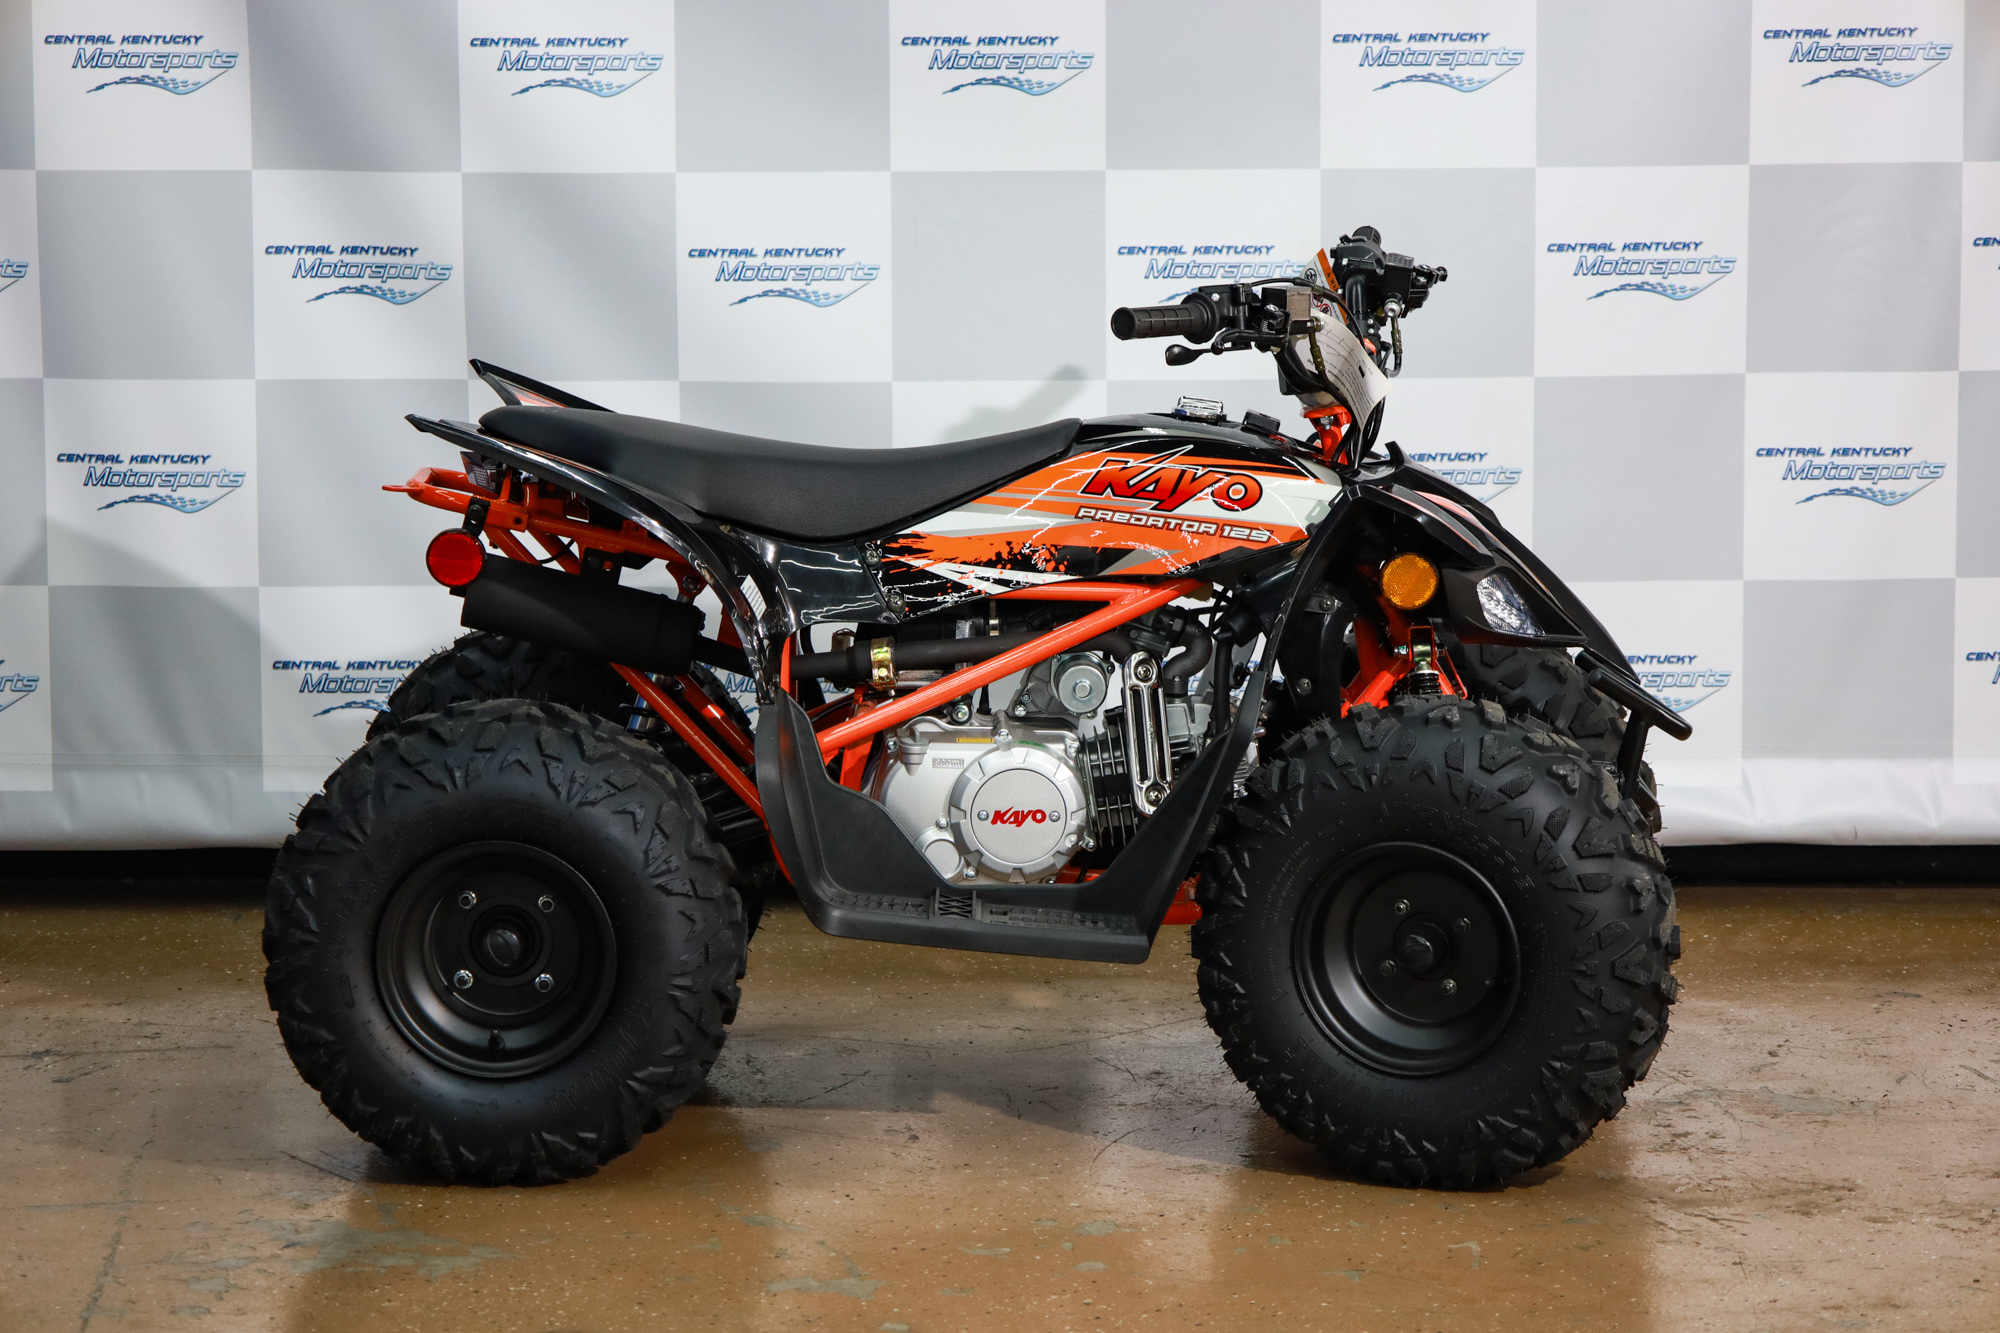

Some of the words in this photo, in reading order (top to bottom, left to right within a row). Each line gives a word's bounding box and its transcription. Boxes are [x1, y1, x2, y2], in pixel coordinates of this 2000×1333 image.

[45, 34, 115, 45] CENTRAL
[121, 34, 204, 45] KENTUCKY
[470, 37, 540, 47] CENTRAL
[546, 37, 629, 47] KENTUCKY
[901, 36, 971, 46] CENTRAL
[976, 36, 1059, 46] KENTUCKY
[1332, 33, 1401, 43] CENTRAL
[1407, 33, 1490, 42] KENTUCKY
[1763, 28, 1831, 39] CENTRAL
[1836, 27, 1917, 37] KENTUCKY
[72, 47, 239, 74] Motorsports
[497, 50, 664, 76] Motorsports
[928, 49, 1094, 74] Motorsports
[1359, 46, 1524, 70] Motorsports
[1789, 41, 1952, 65] Motorsports
[265, 245, 335, 255] CENTRAL
[340, 245, 419, 256] KENTUCKY
[688, 248, 758, 258] CENTRAL
[763, 248, 845, 258] KENTUCKY
[1117, 245, 1187, 255] CENTRAL
[1192, 245, 1274, 255] KENTUCKY
[1546, 242, 1615, 252] CENTRAL
[1621, 241, 1702, 251] KENTUCKY
[292, 258, 453, 283] Motorsports
[715, 261, 880, 285] Motorsports
[1144, 258, 1307, 282] Motorsports
[1573, 255, 1736, 279] Motorsports
[57, 453, 125, 463] CENTRAL
[129, 454, 212, 465] KENTUCKY
[1755, 447, 1824, 456] CENTRAL
[1830, 447, 1912, 456] KENTUCKY
[84, 466, 246, 492] Motorsports
[1078, 444, 1263, 512] KAYO
[1434, 467, 1522, 485] sports
[1781, 460, 1946, 484] Motorsports
[1075, 506, 1219, 535] PREDATOR
[1220, 524, 1273, 543] 125
[272, 660, 341, 670] CENTRAL
[1636, 671, 1732, 692] rsports
[990, 806, 1047, 828] KAYO
